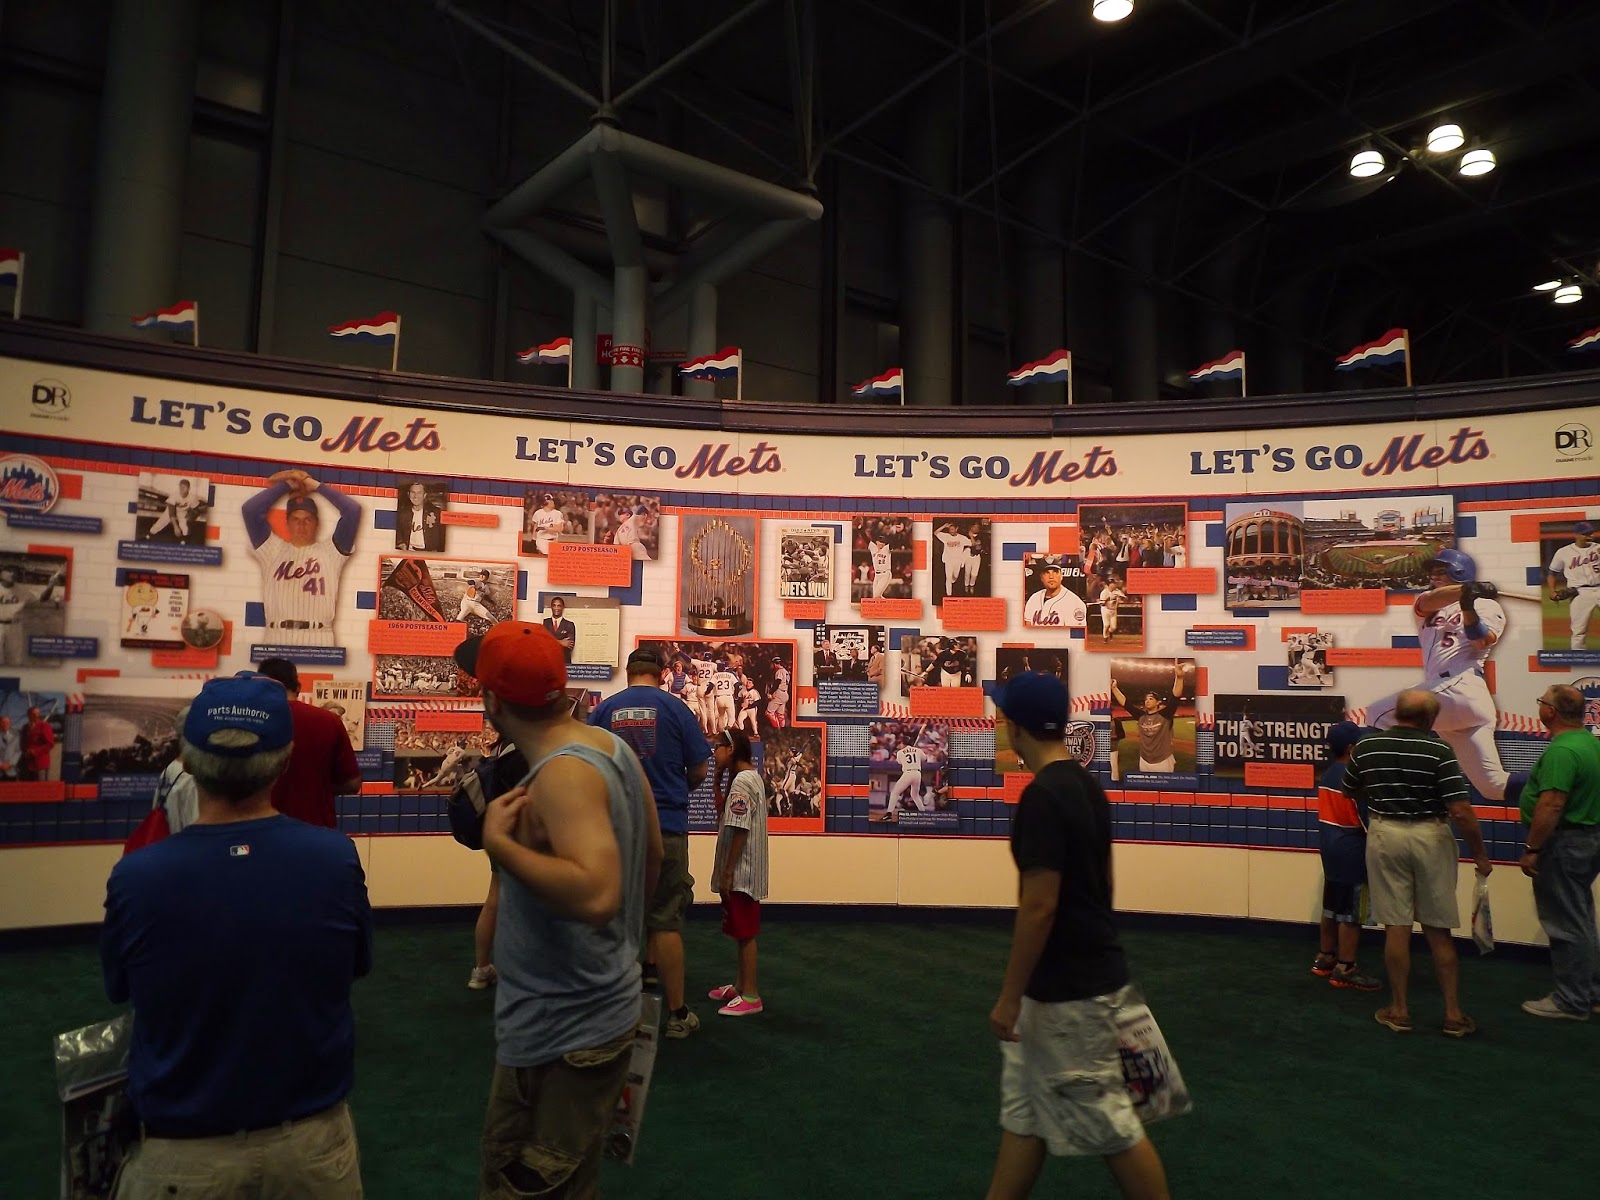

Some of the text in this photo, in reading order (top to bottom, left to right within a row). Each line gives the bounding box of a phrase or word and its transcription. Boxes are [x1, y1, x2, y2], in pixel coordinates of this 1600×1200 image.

[31, 384, 70, 408] DR
[130, 396, 442, 453] LET'S GO Mets
[1554, 429, 1593, 449] DR
[515, 436, 782, 479] LET'S GO Mets
[1190, 427, 1491, 477] LET'S GO Mets
[854, 446, 1118, 487] LET'S GO Mets
[578, 546, 618, 554] POSTSEASON
[1569, 551, 1599, 570] Mets
[274, 558, 321, 581] Mets
[302, 577, 326, 596] 41
[781, 581, 828, 598] METS WIN
[1033, 609, 1060, 625] Mets
[405, 623, 448, 631] POSTSEASON
[1440, 631, 1458, 648] 5
[699, 669, 711, 679] 22
[717, 680, 730, 690] 23
[316, 689, 363, 700] WE WIN IT!
[231, 705, 270, 720] Authority
[1253, 721, 1338, 739] STRENGT
[1216, 741, 1238, 758] TO
[905, 753, 917, 764] 31
